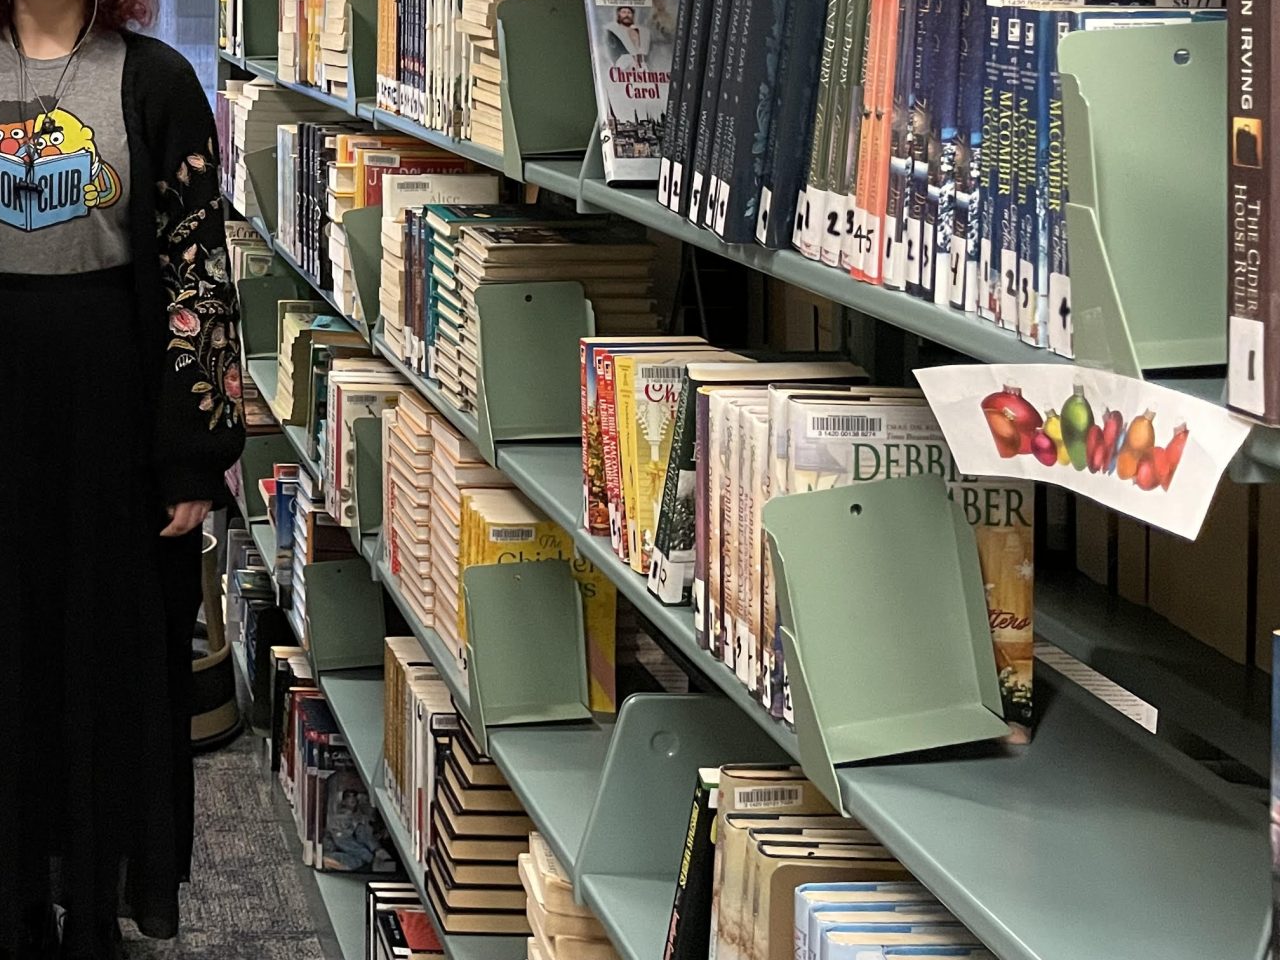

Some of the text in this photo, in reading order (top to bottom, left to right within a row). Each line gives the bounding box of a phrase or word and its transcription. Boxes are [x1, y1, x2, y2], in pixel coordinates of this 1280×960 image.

[609, 66, 671, 83] Christmas
[708, 45, 718, 78] DAYS
[725, 47, 735, 79] DAYS
[819, 37, 836, 88] PERRY
[1240, 27, 1254, 110] IRVING
[625, 84, 660, 100] Carol
[980, 87, 993, 188] MACOMBER
[998, 91, 1013, 195] MACOMBER
[1018, 97, 1028, 204] MACOMBER
[1048, 99, 1062, 211] MACOMBER
[38, 169, 81, 213] CLUB
[827, 211, 841, 237] 2
[846, 210, 855, 234] 3
[853, 224, 867, 254] 4
[865, 229, 874, 253] 5
[907, 240, 915, 261] 2
[1234, 185, 1247, 318] HOUSE RULE
[951, 252, 959, 286] 4
[1247, 200, 1261, 313] THE CIDER
[1005, 269, 1017, 297] 2
[1059, 297, 1070, 330] 4
[1248, 350, 1255, 382] 1
[599, 398, 613, 489] DEBBIE MACOMBER
[852, 442, 979, 483] DEBBI
